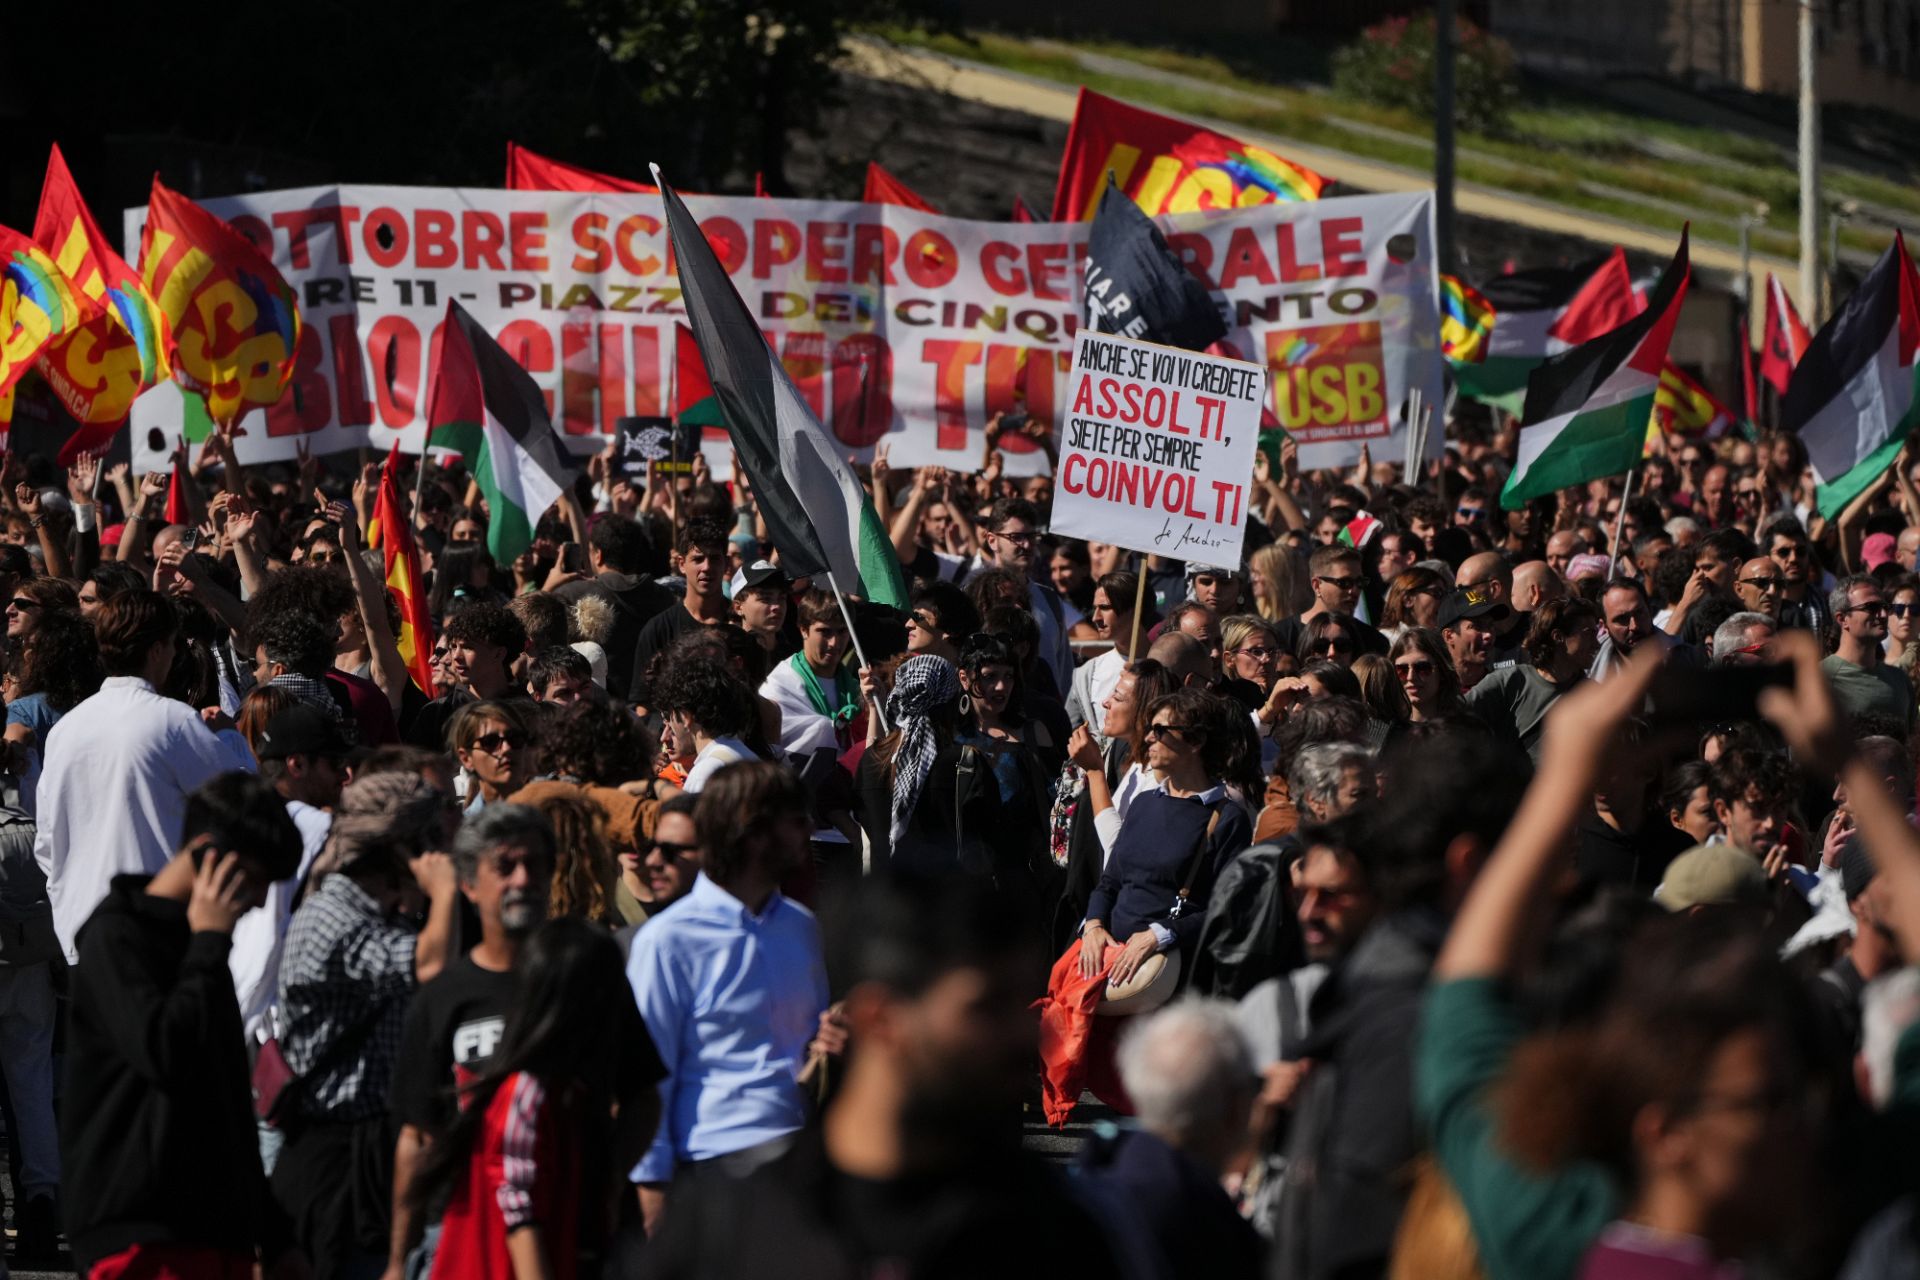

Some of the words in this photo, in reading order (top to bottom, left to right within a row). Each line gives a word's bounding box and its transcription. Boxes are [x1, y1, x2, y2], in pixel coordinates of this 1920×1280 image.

[980, 217, 1368, 302] GERALE
[305, 277, 377, 308] RE
[393, 278, 437, 307] 11
[499, 282, 687, 314] PIAZZ
[1079, 339, 1128, 377] ANCHE
[1128, 349, 1150, 380] SE
[1152, 353, 1176, 384] VOI
[1178, 358, 1191, 388] VI
[1191, 361, 1258, 401] CREDETE
[1275, 363, 1383, 429] USB
[1068, 418, 1111, 454] SIETE
[1112, 427, 1142, 460] PER
[1143, 433, 1203, 472] SEMPRE
[1063, 453, 1242, 526] COINVOLTI
